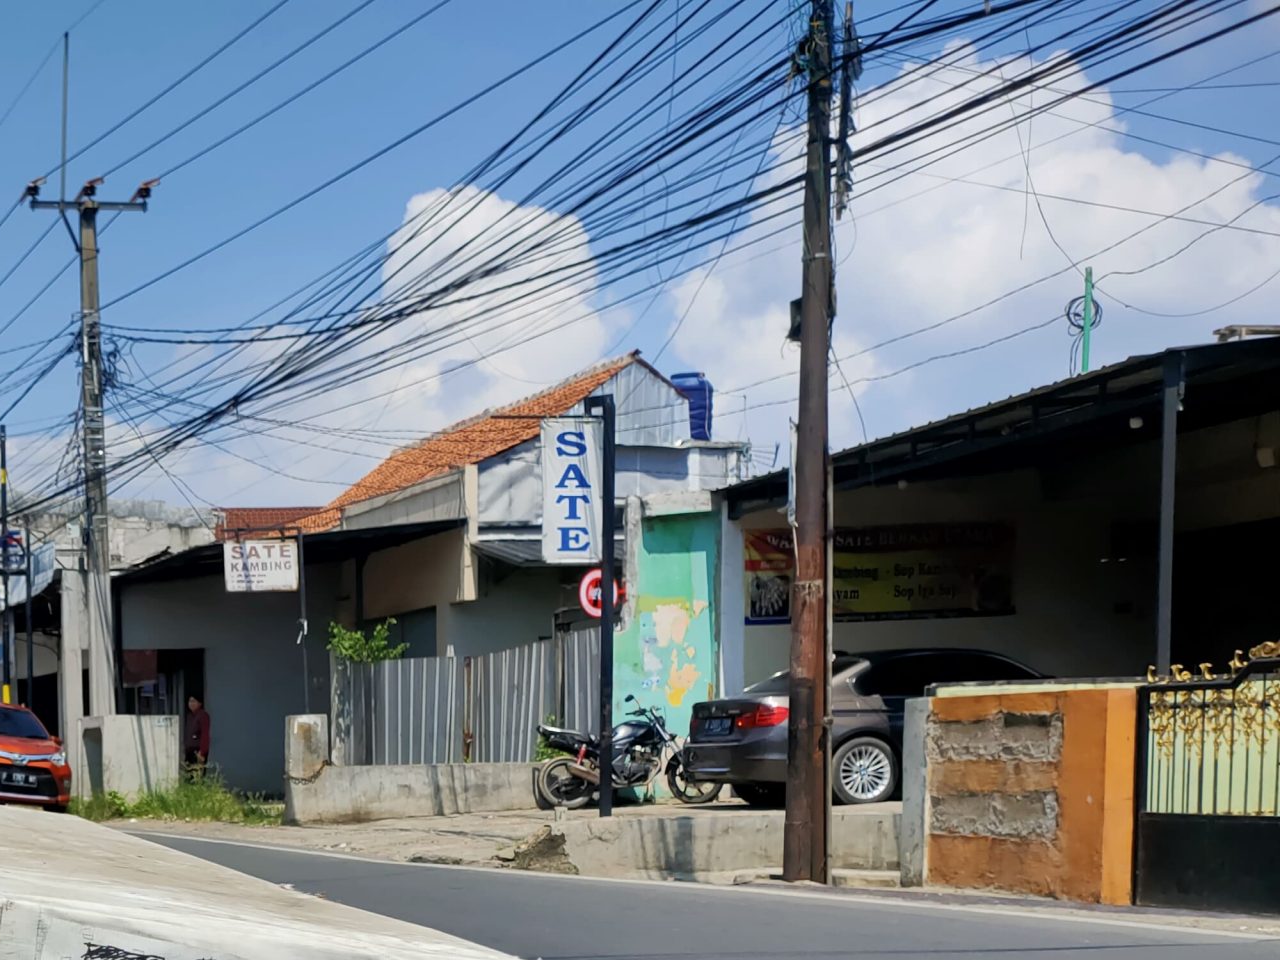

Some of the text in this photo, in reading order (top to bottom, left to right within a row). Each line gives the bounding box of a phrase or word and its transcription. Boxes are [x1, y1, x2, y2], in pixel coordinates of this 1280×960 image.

[555, 431, 591, 552] SATE
[231, 544, 291, 559] SATE
[231, 561, 292, 572] KAMBING
[894, 584, 915, 600] Sop
